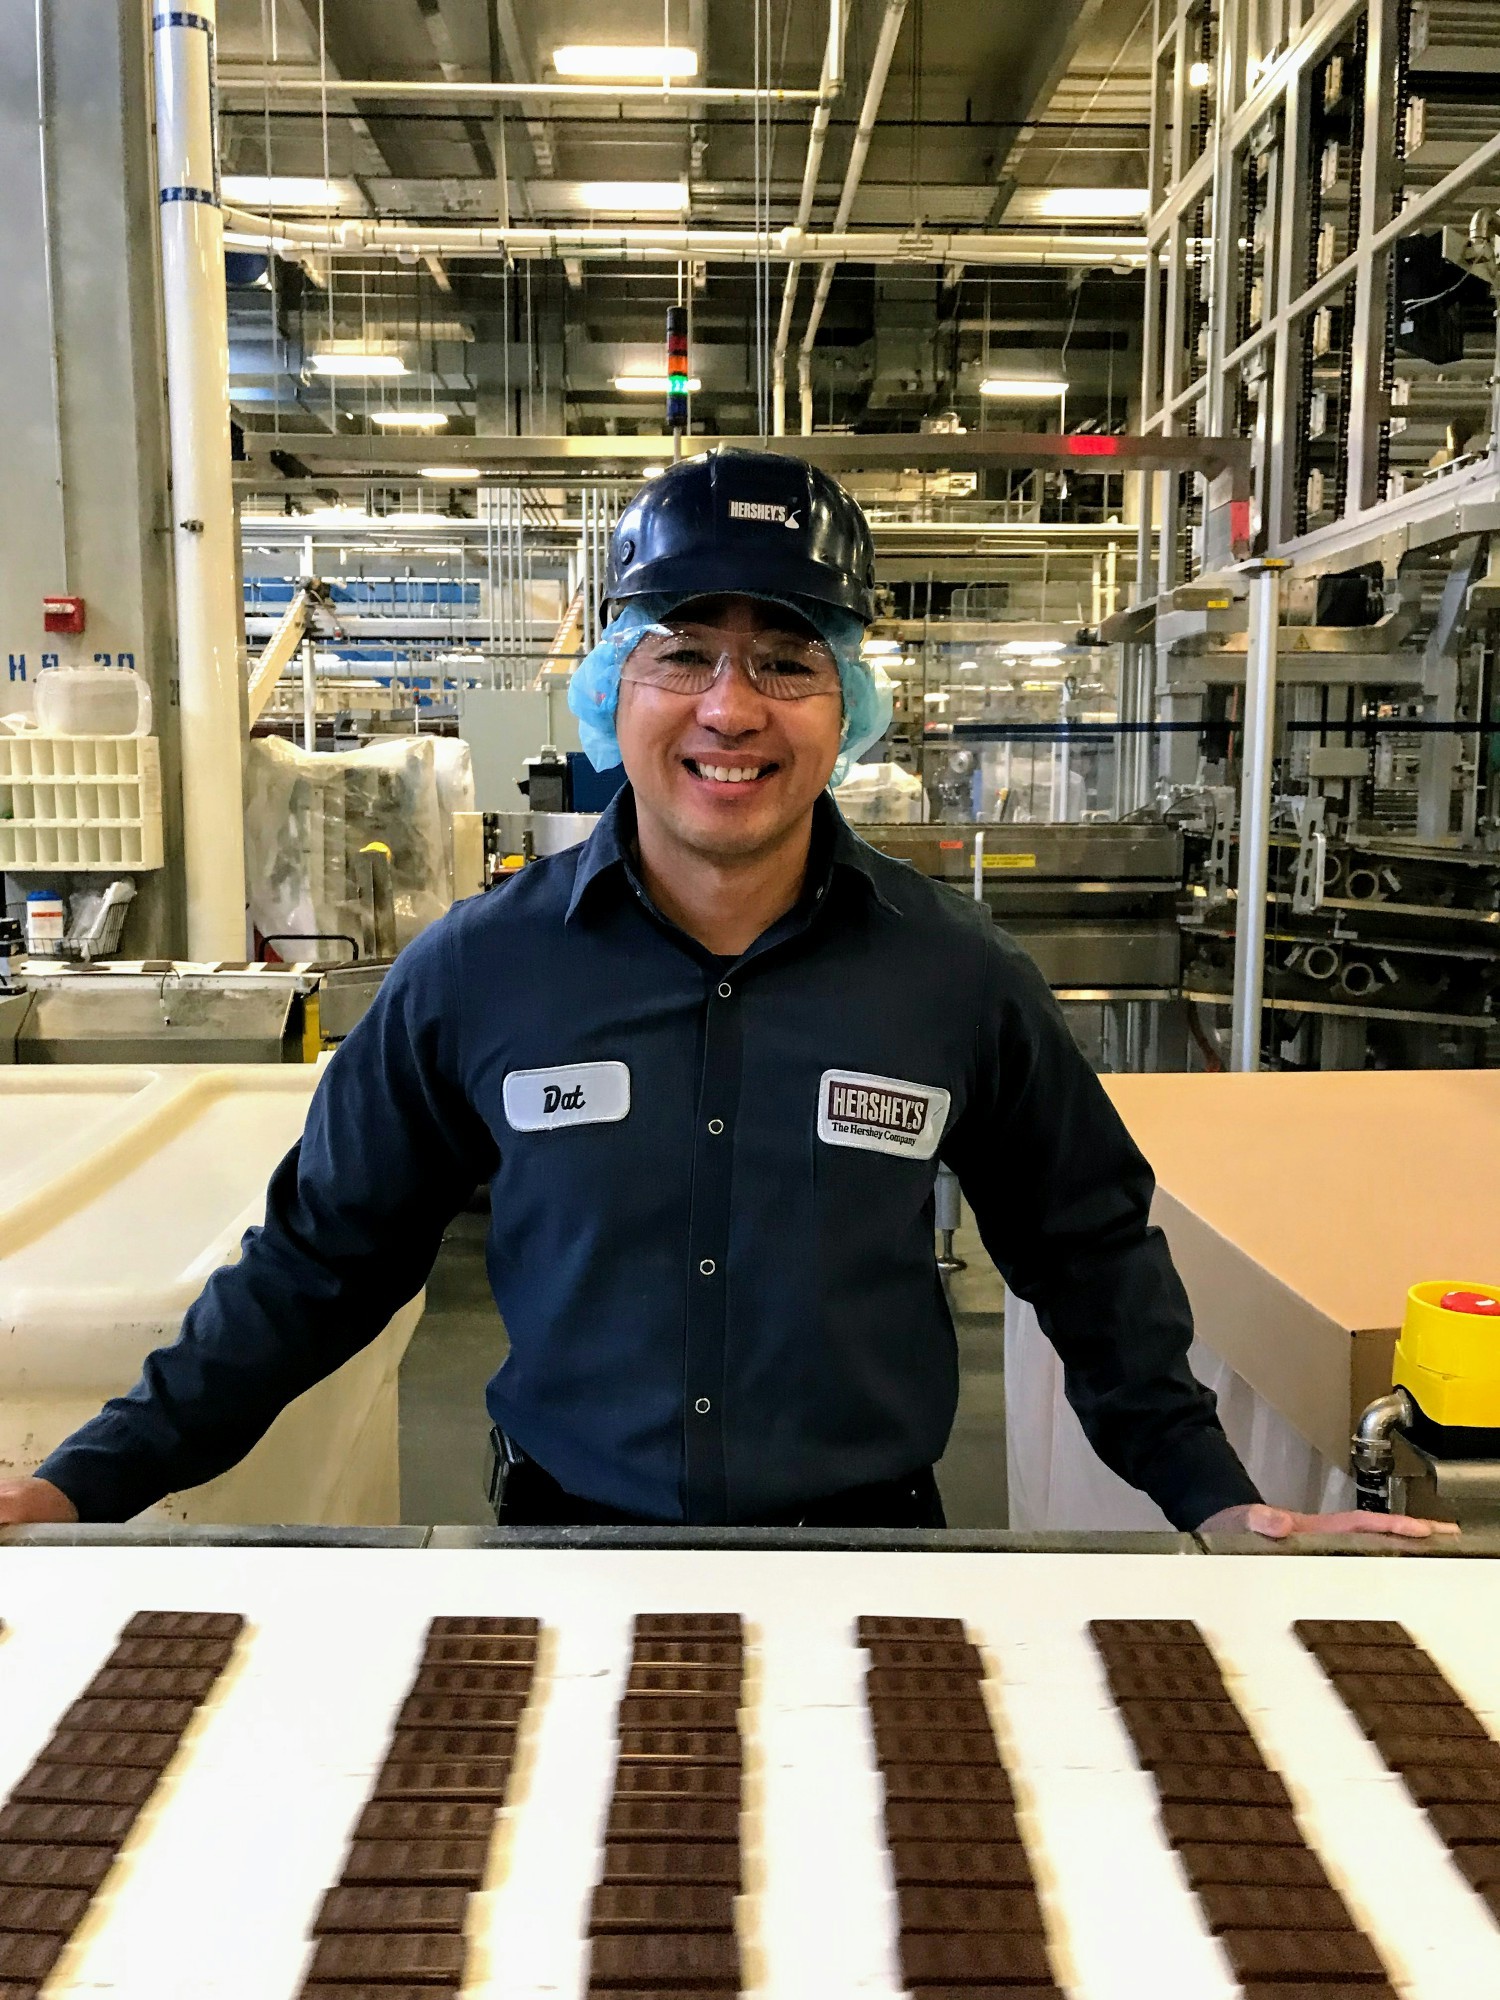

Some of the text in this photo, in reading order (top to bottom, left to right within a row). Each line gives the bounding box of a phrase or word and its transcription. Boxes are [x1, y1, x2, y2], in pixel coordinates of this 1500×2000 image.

[730, 501, 786, 522] HERSHEY'S
[543, 1085, 586, 1113] Dat
[832, 1086, 925, 1130] HERSHEY'S
[831, 1121, 917, 1147] The Hershey Company
